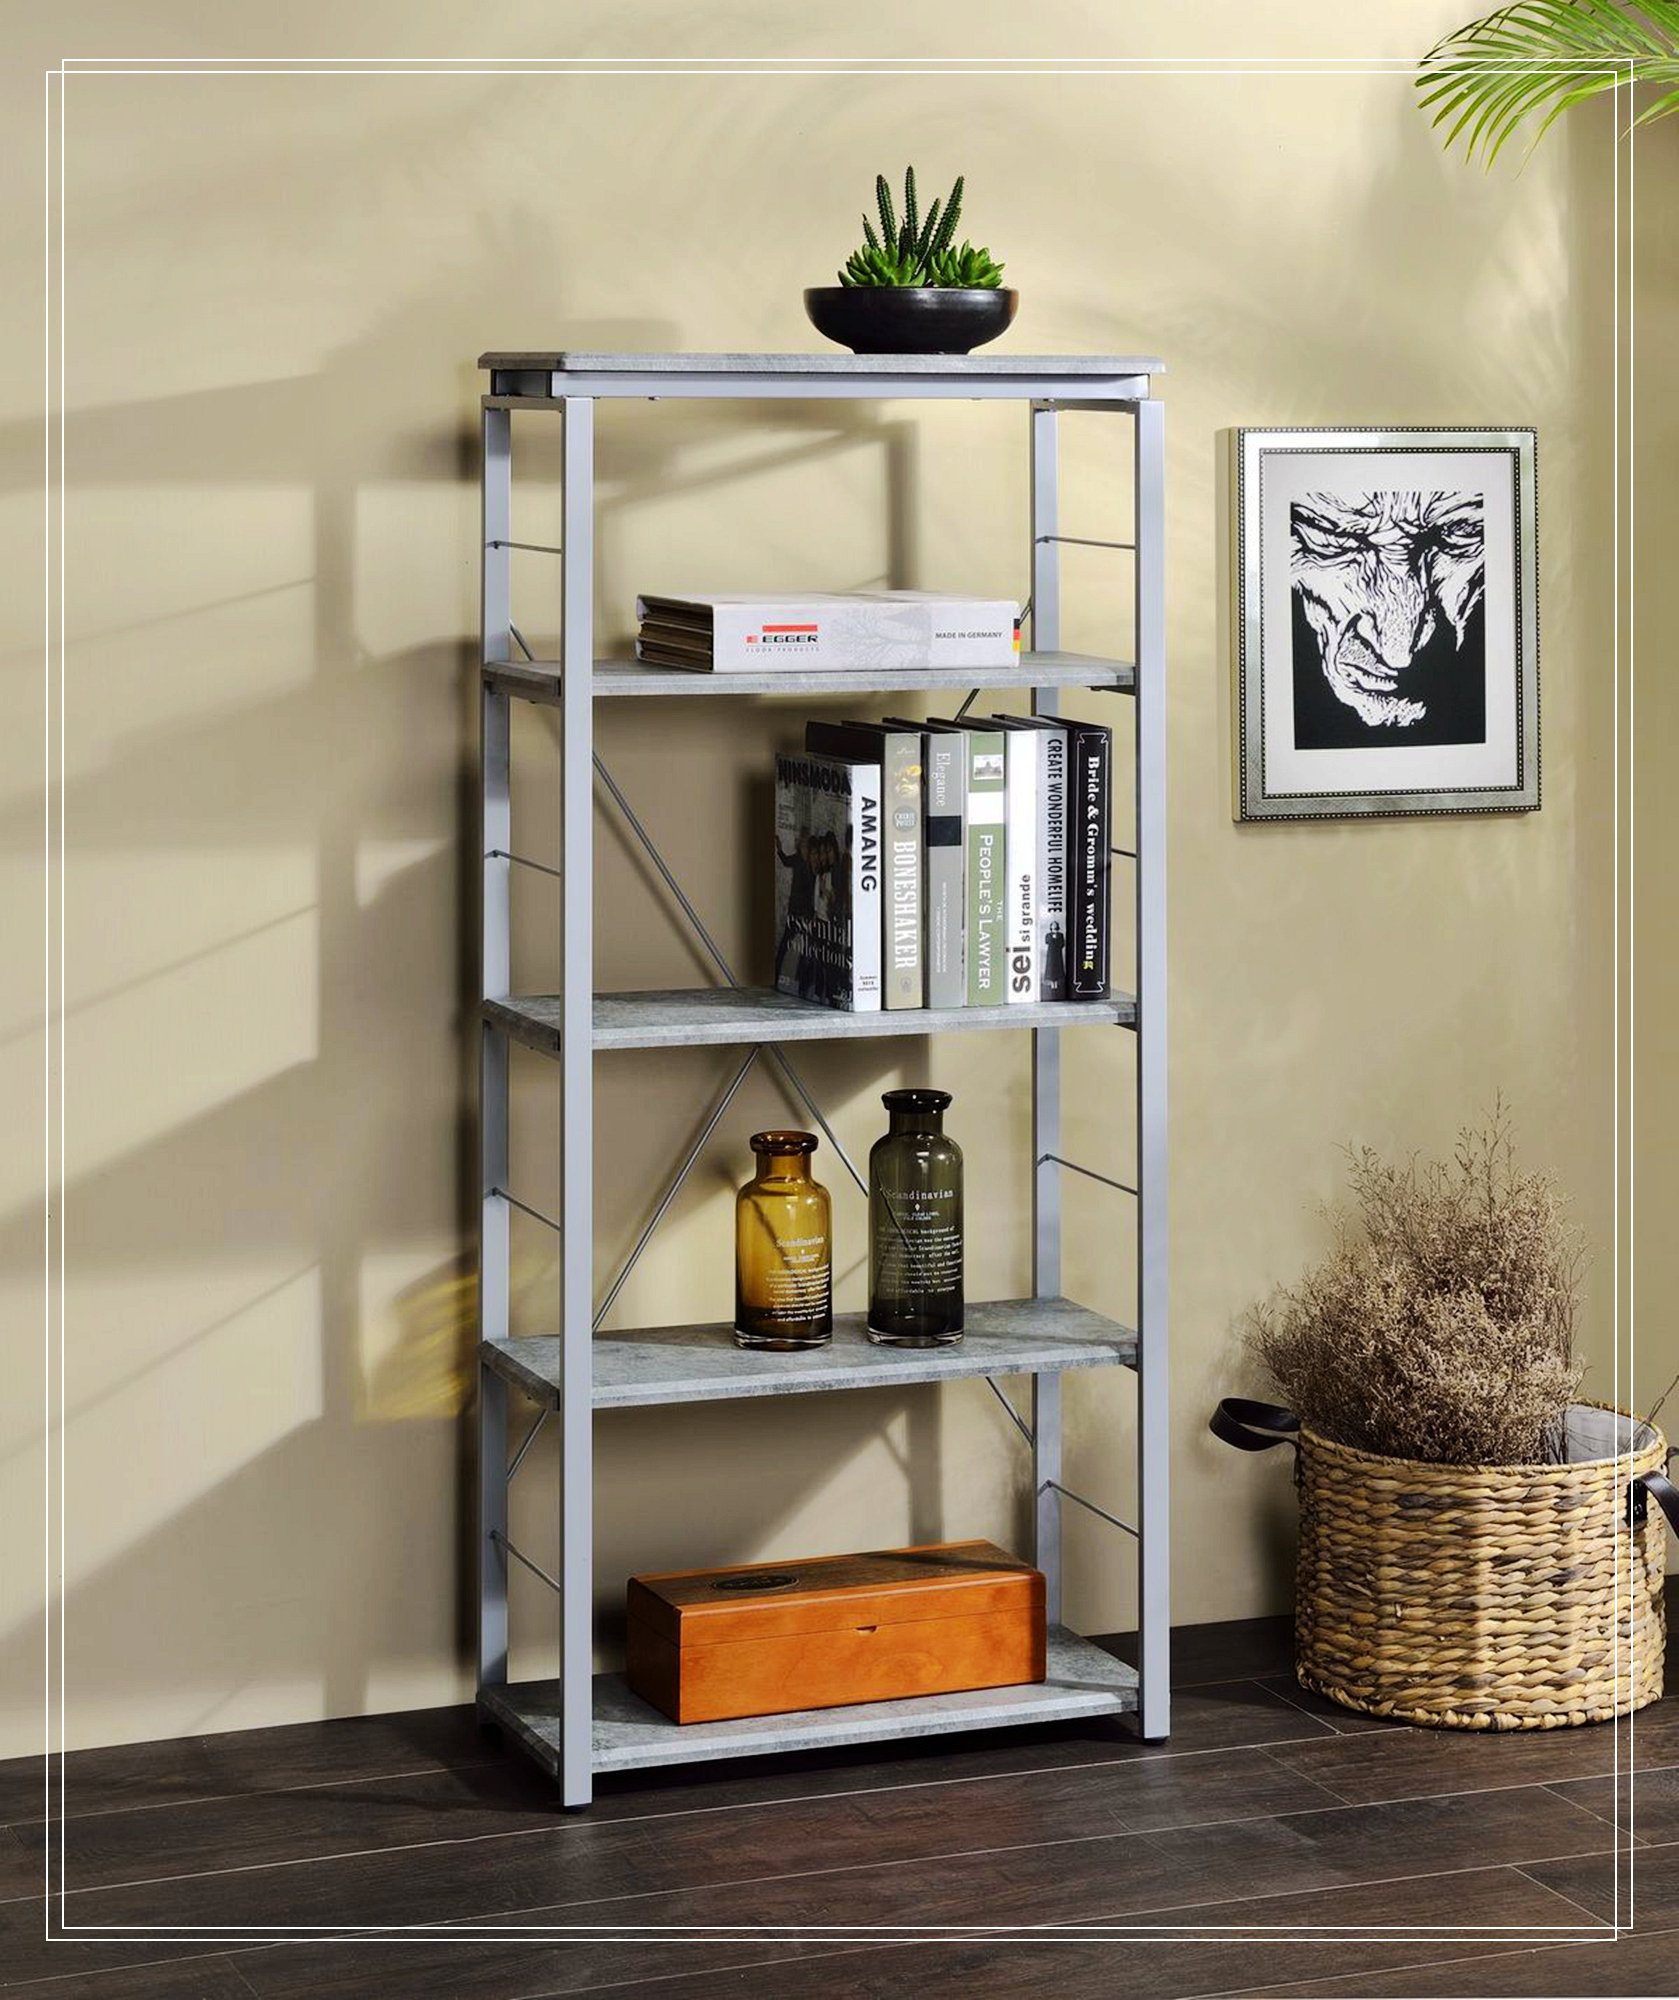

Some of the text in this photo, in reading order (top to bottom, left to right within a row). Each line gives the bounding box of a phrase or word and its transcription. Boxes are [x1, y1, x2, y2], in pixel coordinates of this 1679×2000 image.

[762, 635, 818, 643] EGGER
[935, 631, 1003, 639] MADE IN GERMANY
[931, 752, 951, 807] Elegance
[1087, 756, 1100, 802] Bride
[1047, 738, 1063, 913] CREATE WONDERFUL HOMELIFE
[1087, 805, 1100, 820] &
[861, 796, 877, 892] AMANG
[786, 914, 852, 948] essential
[893, 840, 917, 969] BONESHAKER
[978, 834, 994, 989] PEOPLE'S LAWYER
[786, 932, 853, 970] collections
[1005, 874, 1033, 993] sei si grande
[1083, 903, 1098, 970] wedding
